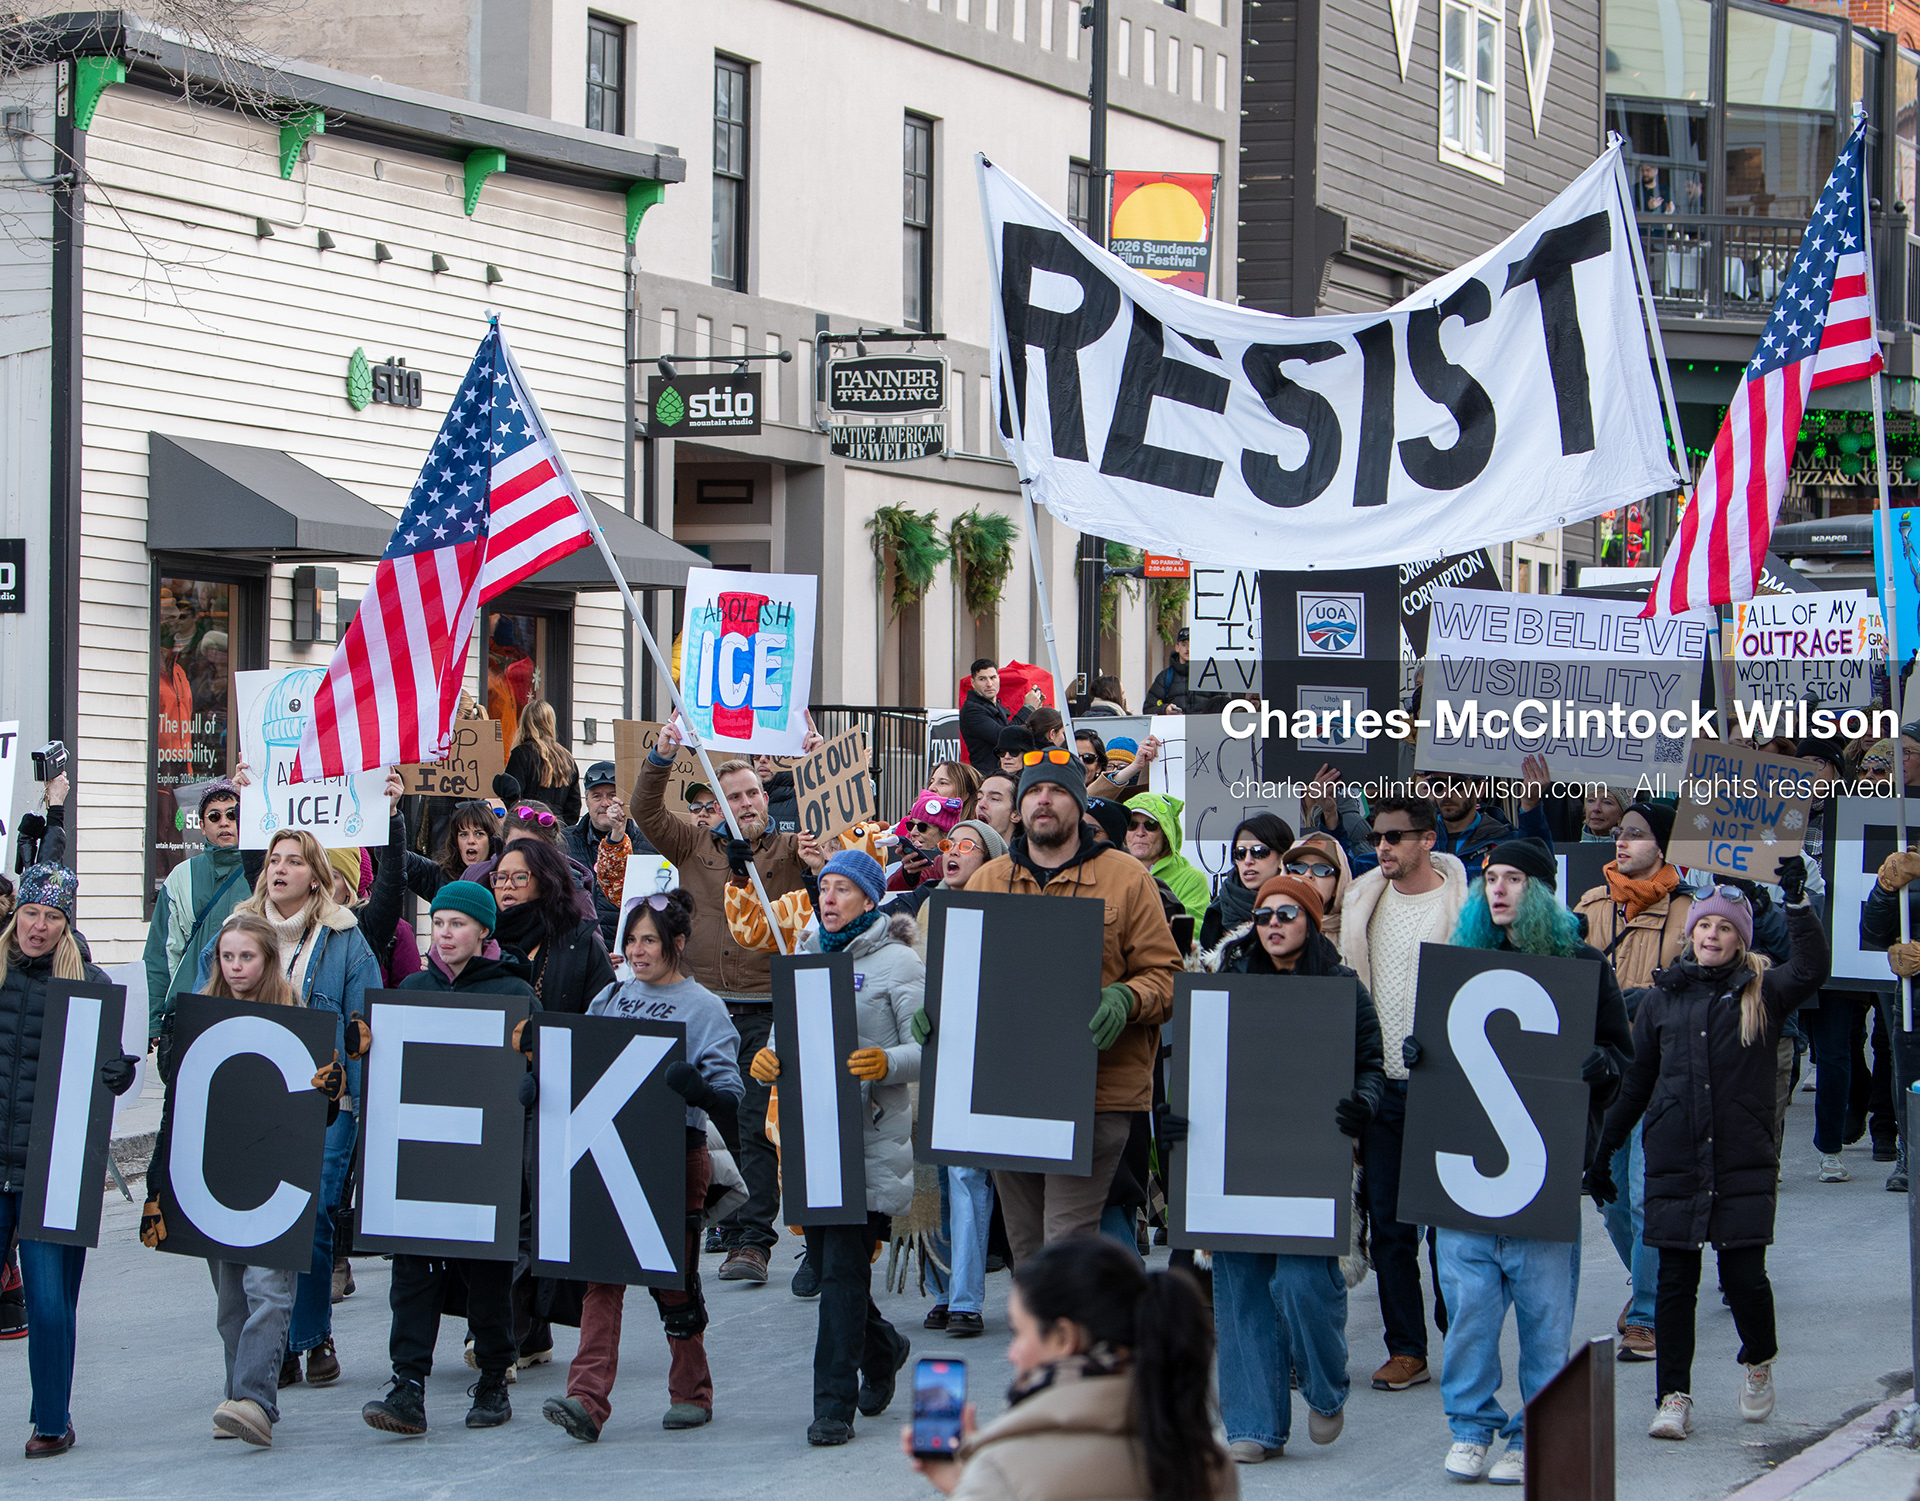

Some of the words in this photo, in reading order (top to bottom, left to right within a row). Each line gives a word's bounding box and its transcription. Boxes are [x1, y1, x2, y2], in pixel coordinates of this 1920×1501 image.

[1111, 240, 1140, 252] 2026
[1143, 241, 1208, 256] Sundance
[1119, 252, 1144, 264] Film
[1146, 253, 1197, 267] Festival
[999, 210, 1612, 508] RESIST
[371, 355, 422, 407] stio
[835, 369, 939, 388] TANNER
[689, 386, 753, 418] stio
[836, 388, 939, 402] TRADING
[689, 419, 727, 427] mountain
[728, 417, 754, 426] studio
[832, 427, 876, 444] NATIVE
[880, 426, 942, 443] AMERICAN
[845, 442, 928, 460] JEWELRY
[703, 597, 792, 628] ABOLISH
[1315, 606, 1348, 620] UOA
[1747, 604, 1786, 628] ALL
[1792, 603, 1817, 625] OF
[1828, 600, 1857, 624] MY
[1433, 601, 1510, 643] WE
[1514, 607, 1706, 659] BELIEVE
[1742, 628, 1854, 659] OUTRAGE
[696, 630, 788, 709] ICE
[1441, 654, 1681, 709] VISIBILITY
[1802, 660, 1836, 681] FIT
[1840, 659, 1864, 679] ON
[1748, 683, 1797, 705] THIS
[159, 712, 178, 734] The
[181, 712, 202, 739] pull
[204, 714, 216, 735] of
[158, 741, 218, 769] possibility.
[795, 755, 826, 798] ICE
[826, 732, 860, 779] OUT
[157, 773, 179, 786] Explore
[1693, 753, 1743, 788] UTAH
[1754, 763, 1815, 801] NEEDS
[288, 794, 342, 826] ICE!
[804, 790, 832, 840] OF
[834, 770, 870, 824] UT
[1715, 788, 1786, 828] SNOW
[1712, 821, 1755, 842] NOT
[1708, 840, 1754, 872] ICE
[645, 1002, 676, 1019] ICE
